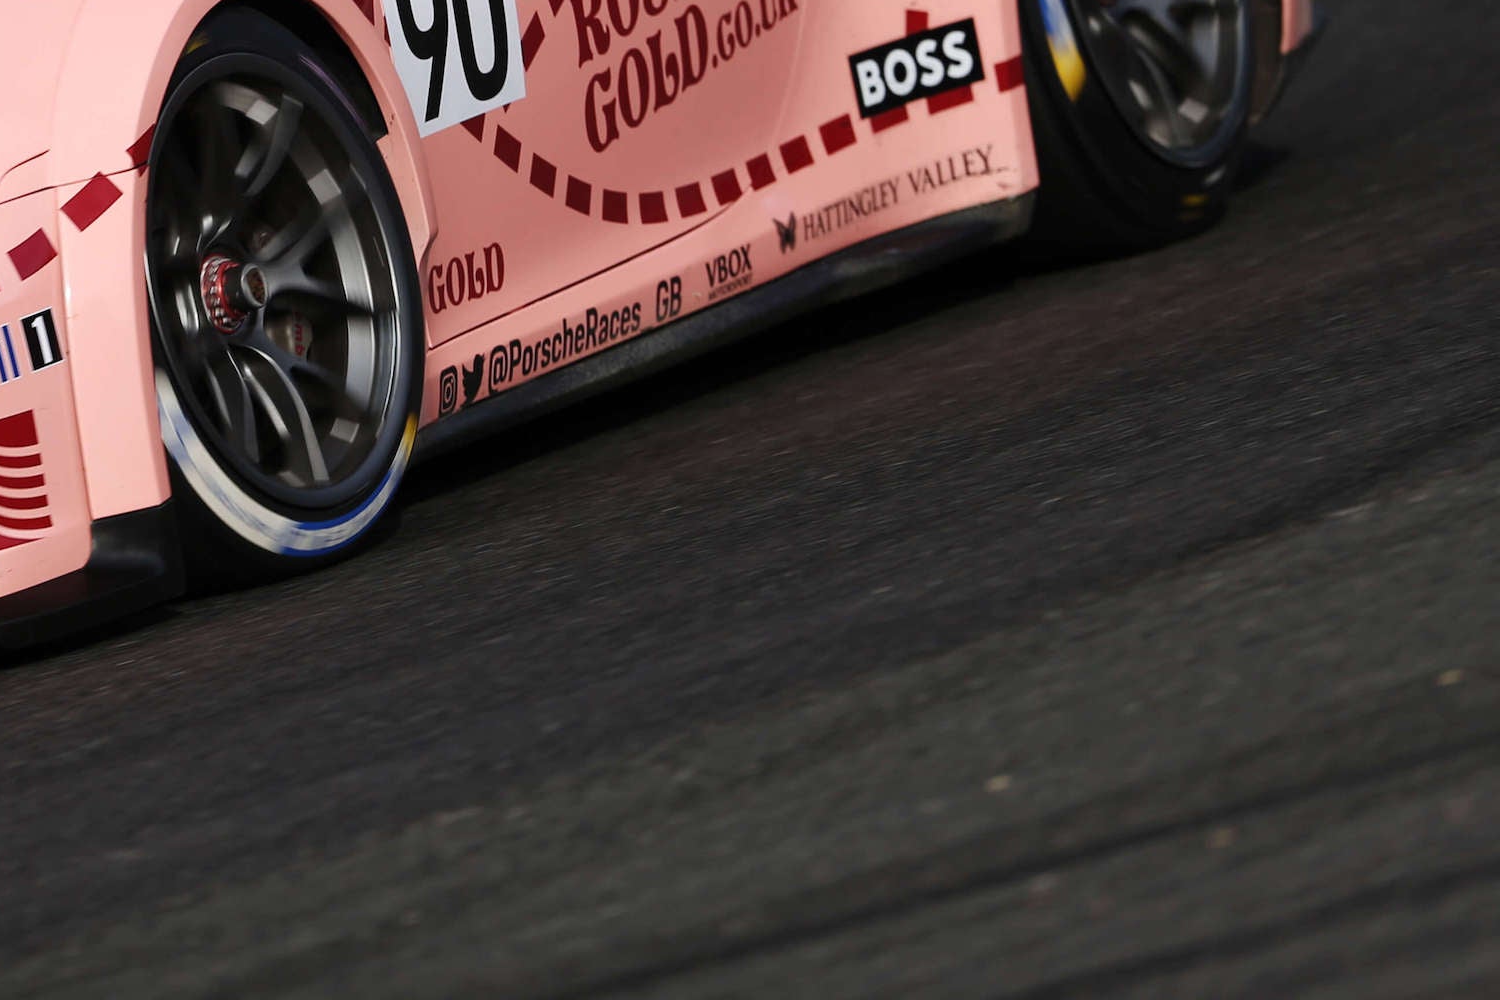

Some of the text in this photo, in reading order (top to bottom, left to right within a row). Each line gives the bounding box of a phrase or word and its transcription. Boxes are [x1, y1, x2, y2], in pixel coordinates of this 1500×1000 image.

[855, 30, 975, 108] BOSS
[803, 144, 993, 242] HATTINGLEY VALLEY
[429, 242, 505, 315] GOLD
[705, 243, 752, 288] VBOX
[29, 313, 60, 366] 1
